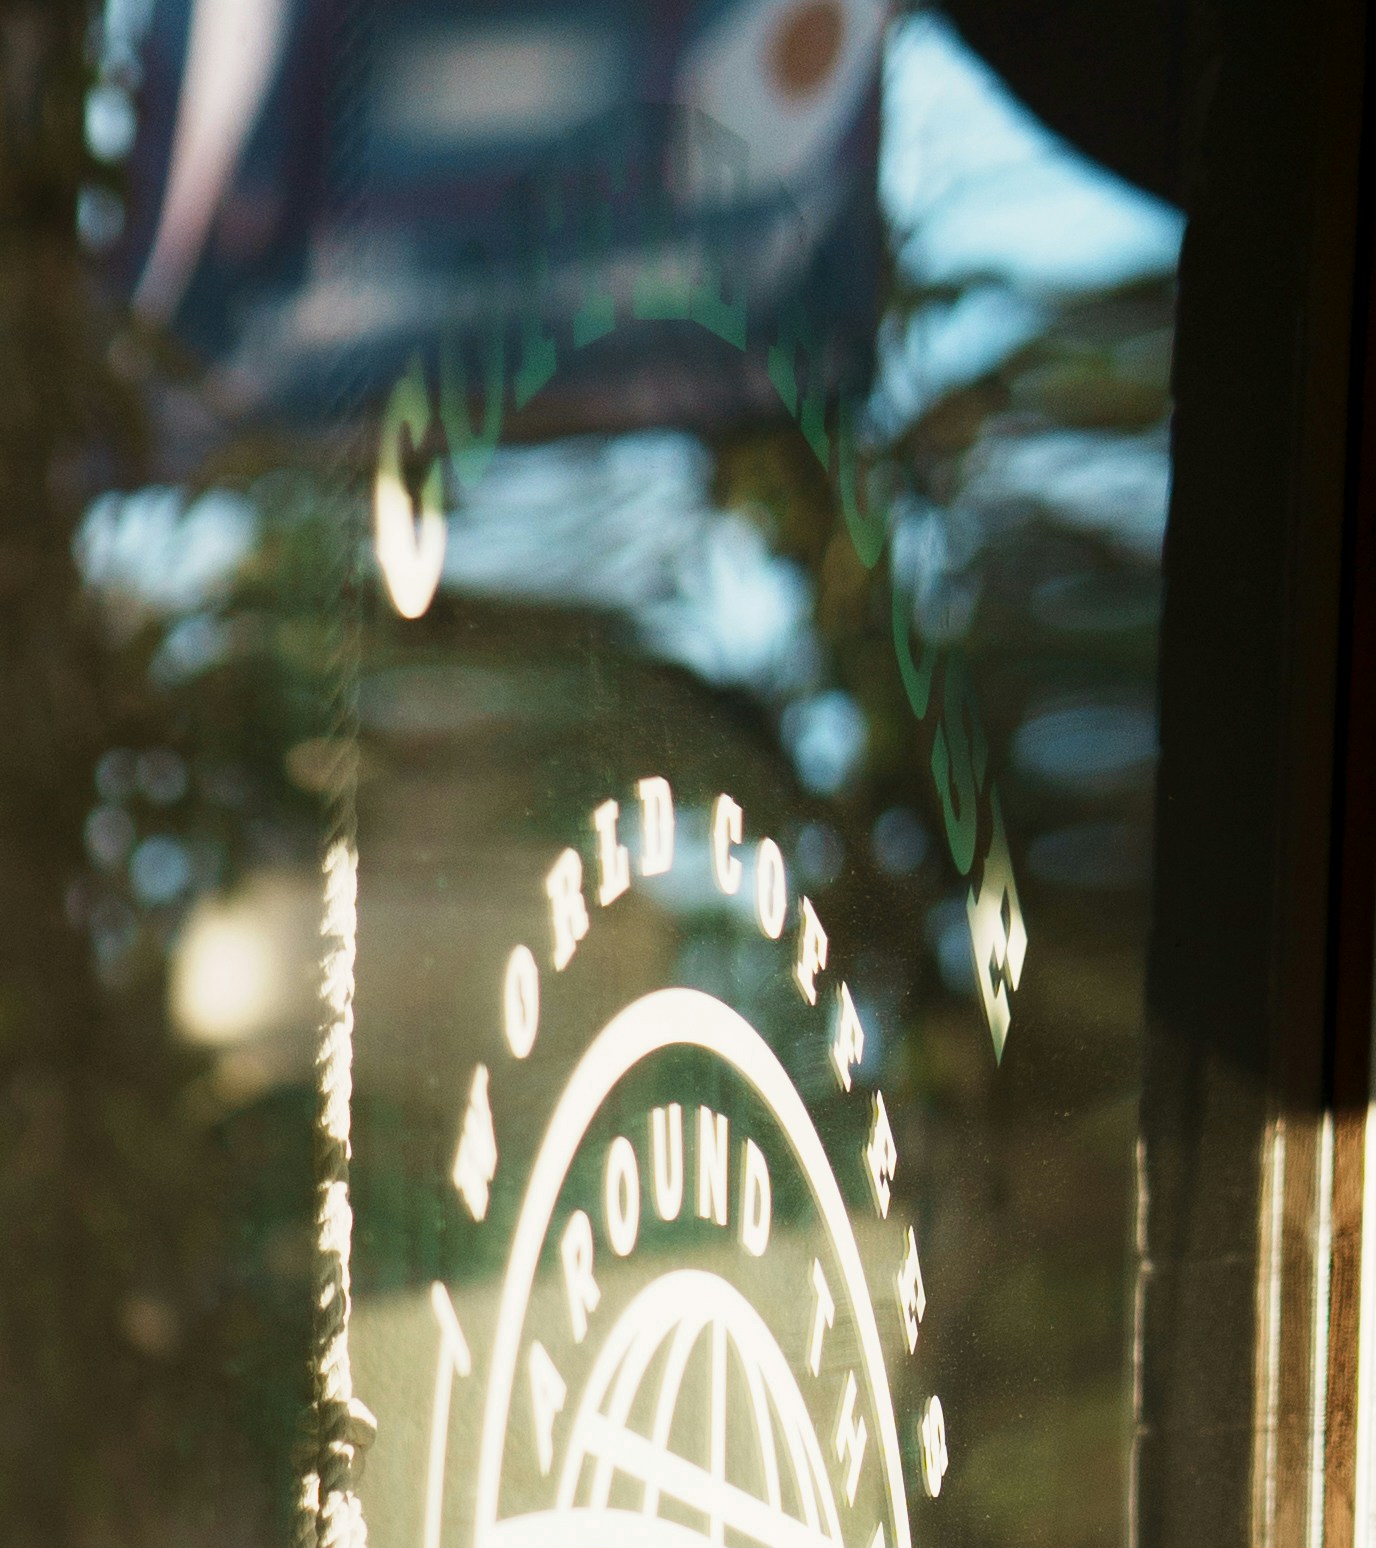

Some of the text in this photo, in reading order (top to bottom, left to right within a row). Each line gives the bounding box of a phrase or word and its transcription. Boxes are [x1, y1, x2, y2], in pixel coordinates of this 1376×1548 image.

[453, 775, 949, 1499] WORLD COFFEES
[531, 1102, 772, 1476] AROUND
